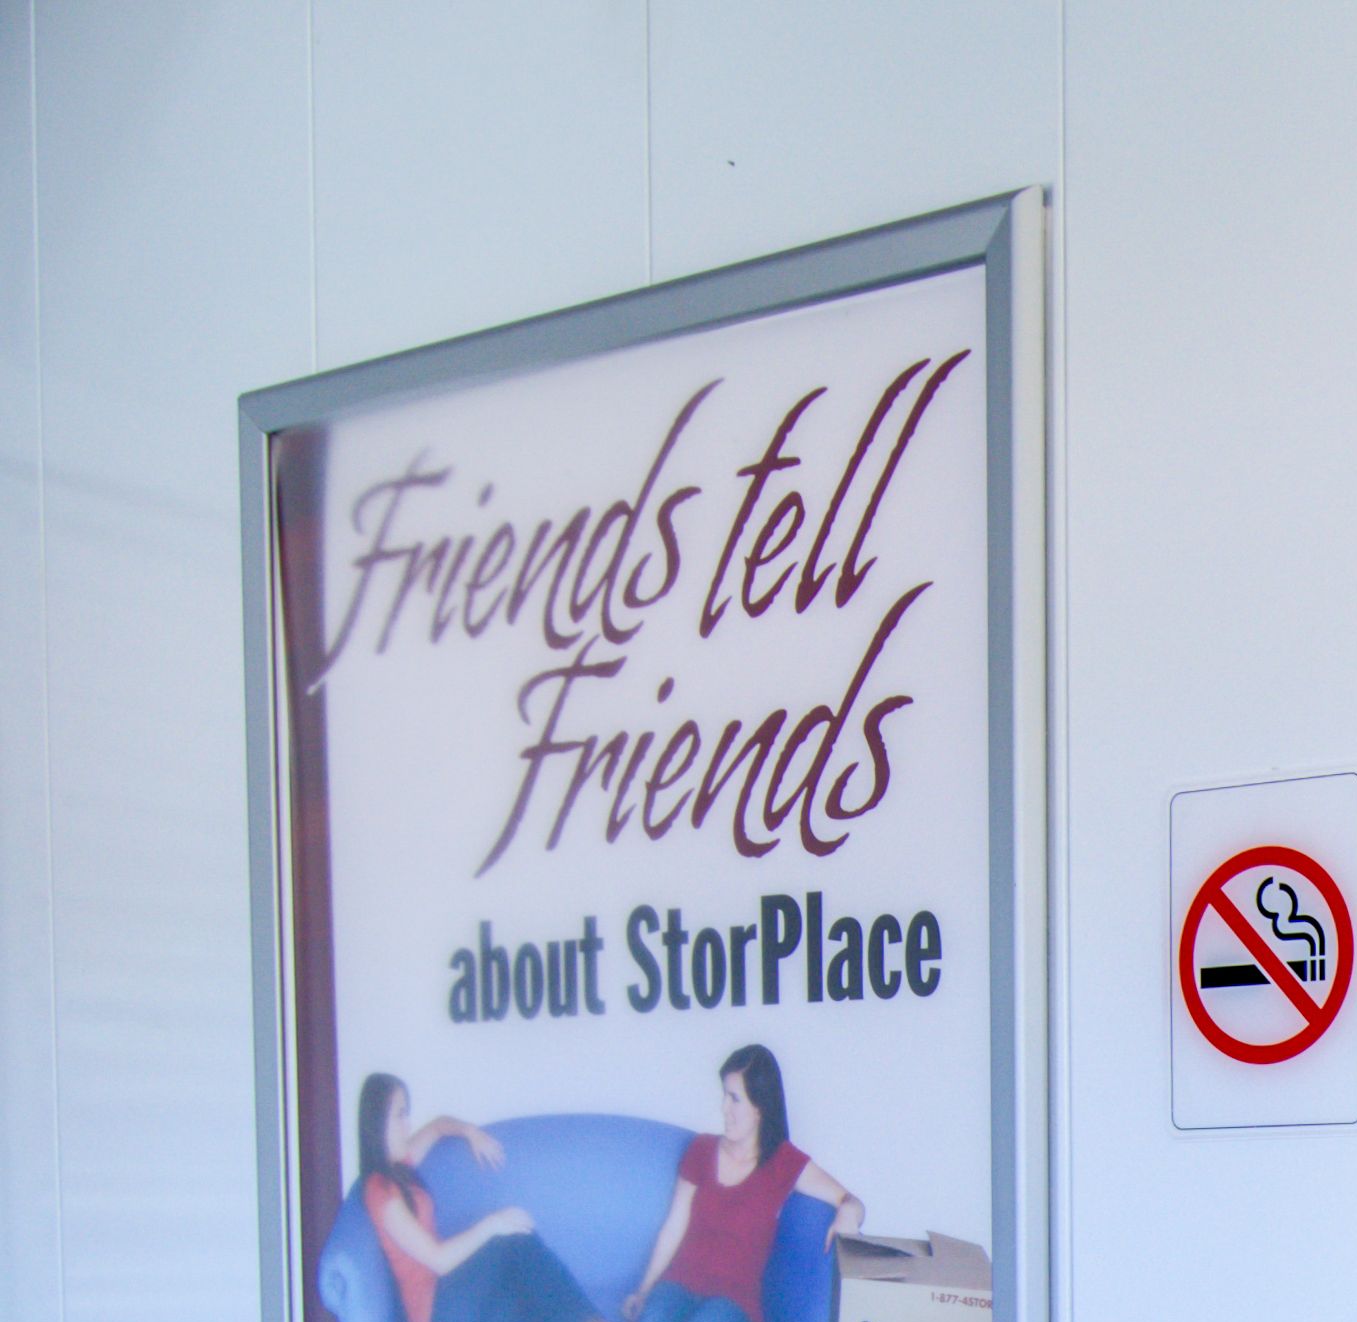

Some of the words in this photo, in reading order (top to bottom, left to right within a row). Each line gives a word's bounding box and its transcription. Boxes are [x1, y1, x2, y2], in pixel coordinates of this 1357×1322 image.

[307, 378, 725, 695] Friends
[699, 348, 972, 639] tell
[475, 581, 934, 879] Friends
[448, 915, 606, 1025] about
[626, 891, 943, 1017] StorPlace
